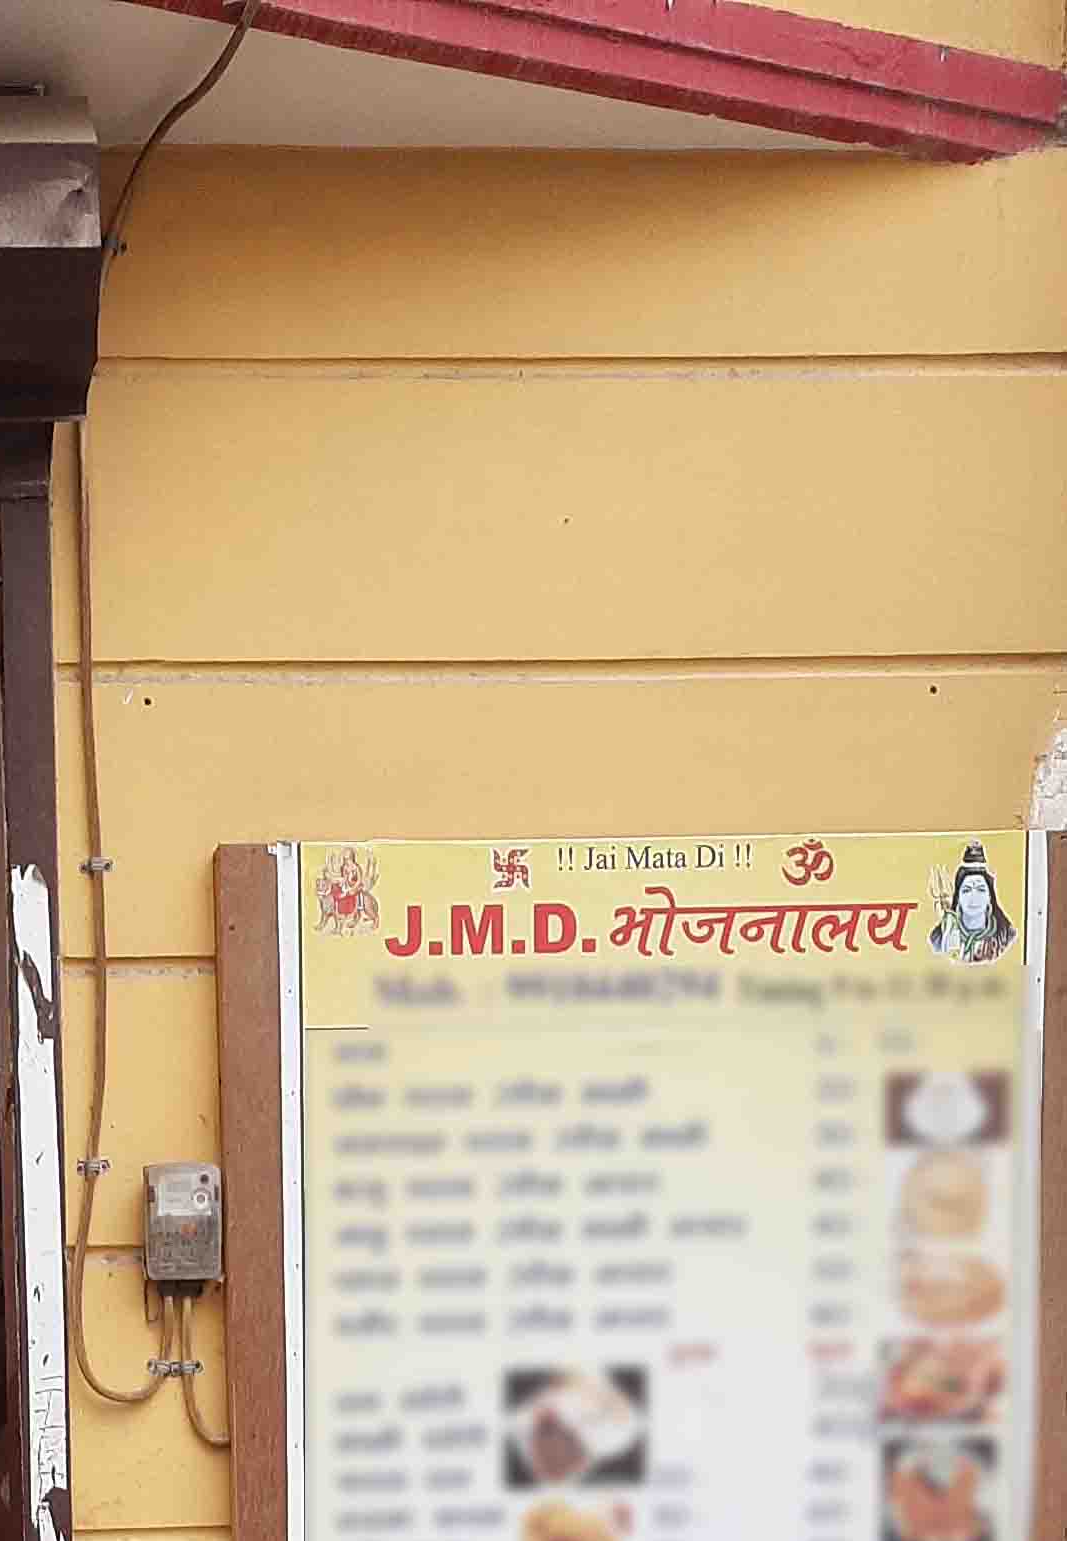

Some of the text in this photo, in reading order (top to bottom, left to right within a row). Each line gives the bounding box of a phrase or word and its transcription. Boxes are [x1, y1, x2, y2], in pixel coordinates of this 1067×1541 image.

[583, 846, 616, 871] Jai
[625, 845, 687, 870] Mata
[695, 844, 725, 869] Di
[384, 885, 918, 957] J.M.D. भोजनालय
